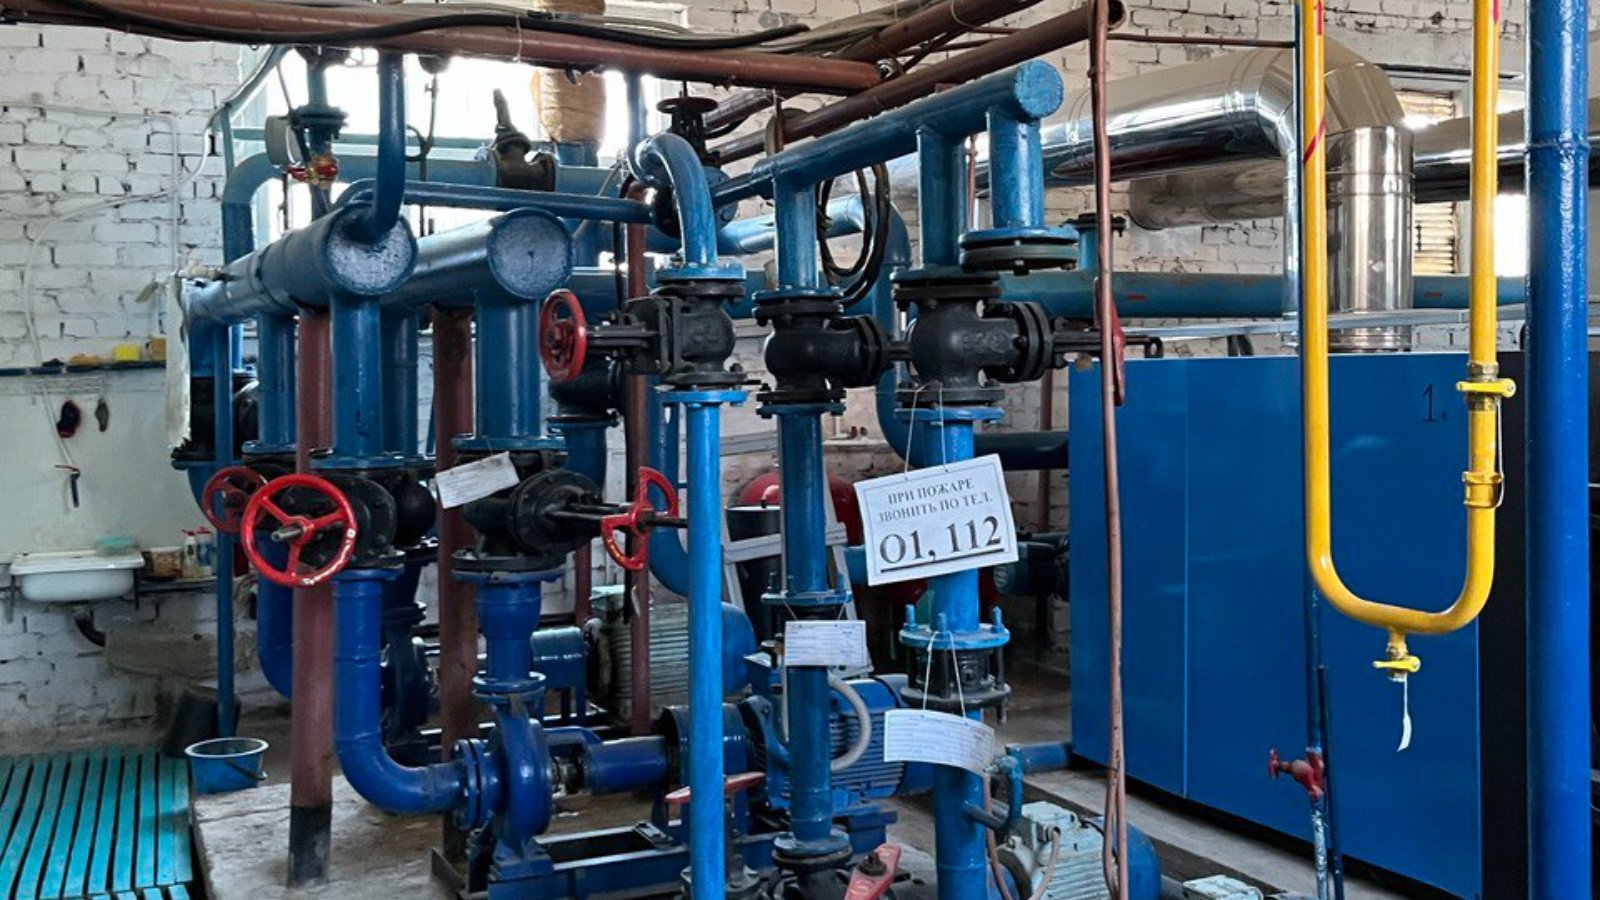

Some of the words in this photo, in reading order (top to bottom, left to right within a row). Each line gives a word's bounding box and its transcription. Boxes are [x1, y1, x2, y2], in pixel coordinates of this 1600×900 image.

[888, 488, 914, 504] ПРИ
[917, 478, 974, 499] ПОЖАРЕ
[879, 502, 937, 523] ЗВОНИТЬ
[940, 497, 960, 510] ПО
[962, 492, 993, 507] ТЕЛ.
[946, 515, 1001, 553] 112
